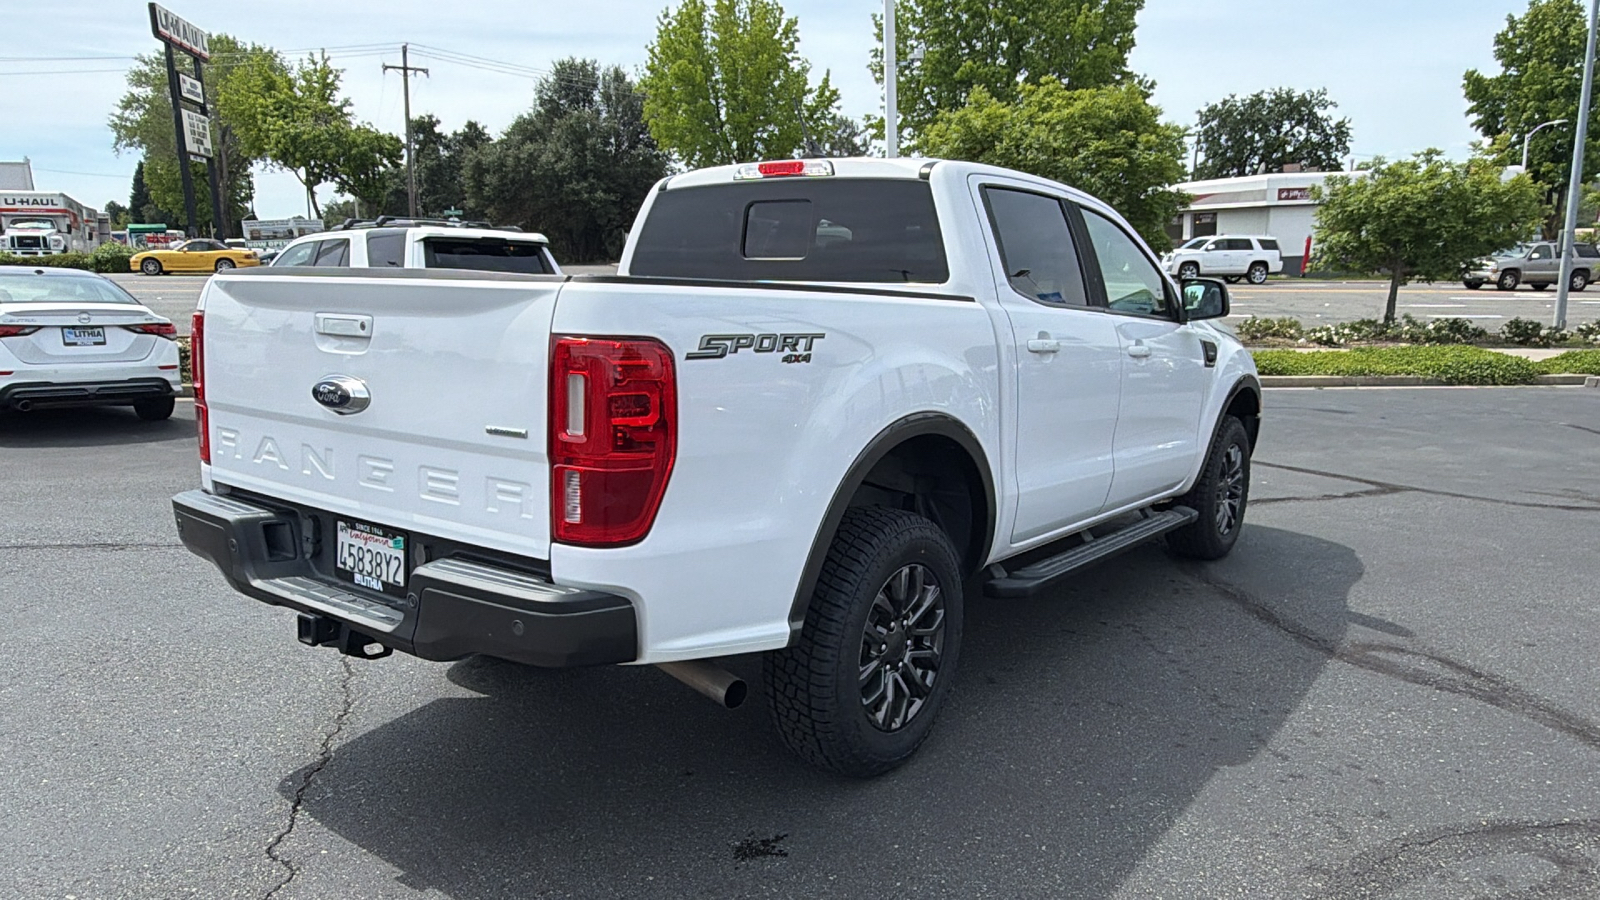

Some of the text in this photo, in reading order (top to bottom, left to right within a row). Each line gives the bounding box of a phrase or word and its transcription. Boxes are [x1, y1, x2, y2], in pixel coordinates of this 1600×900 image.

[74, 330, 102, 338] LITHIA
[684, 333, 826, 360] SPORT
[317, 384, 342, 403] Ford
[215, 425, 534, 519] RANGER
[355, 523, 383, 535] SINCE 1946
[349, 530, 390, 547] California
[339, 541, 402, 585] 45838Y2
[359, 575, 383, 592] LITHIA
